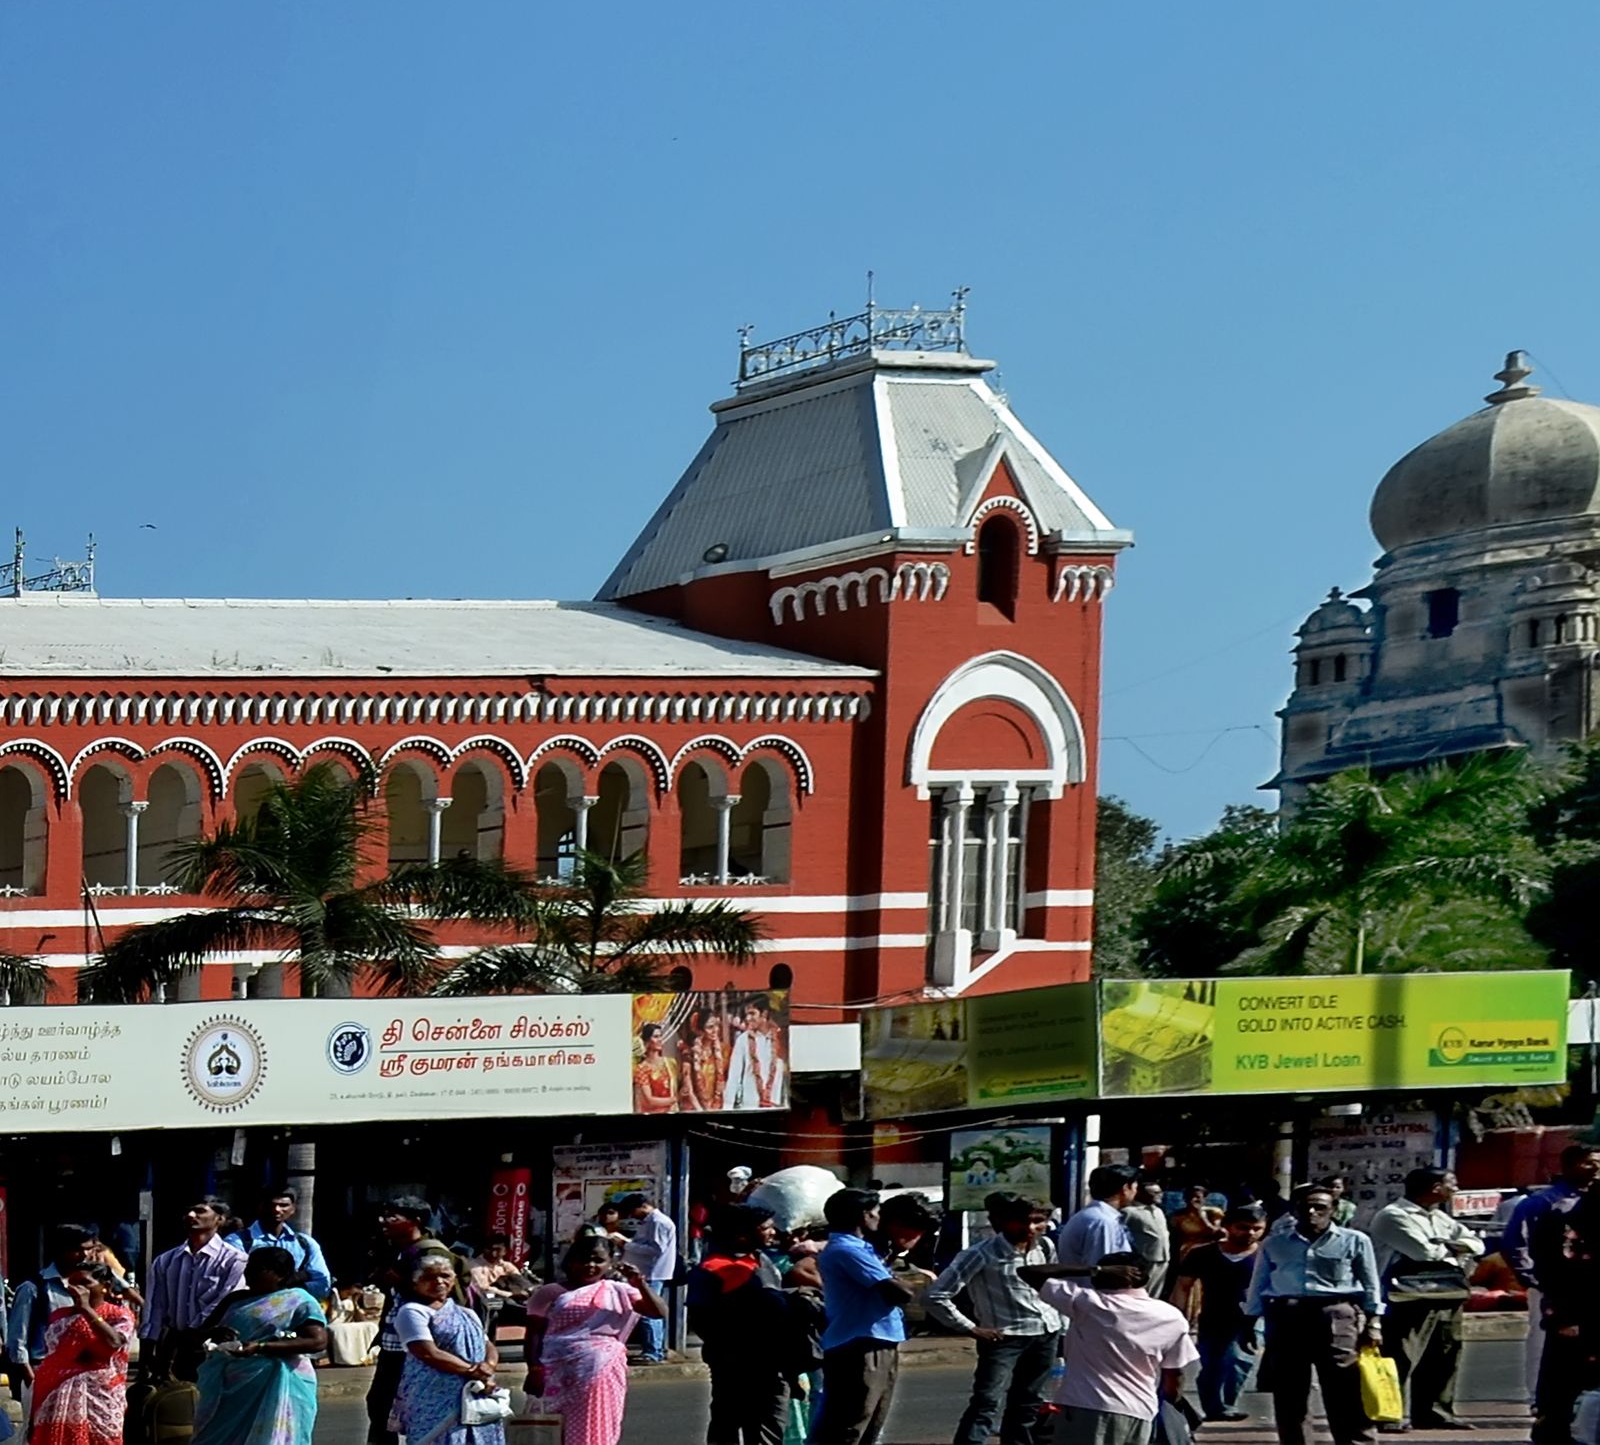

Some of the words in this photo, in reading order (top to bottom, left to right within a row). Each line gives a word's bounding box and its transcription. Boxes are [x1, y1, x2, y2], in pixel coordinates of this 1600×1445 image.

[1239, 996, 1303, 1011] CONVERT
[1307, 995, 1338, 1009] IDLE
[1237, 1017, 1276, 1032] GOLD
[1280, 1017, 1312, 1031] INTO
[1316, 1015, 1362, 1030] ACTIVE
[1367, 1014, 1407, 1029] CASH.
[380, 1020, 402, 1049] தி
[412, 1018, 503, 1042] சென்னை
[509, 1016, 590, 1039] சில்க்ஸ்
[1526, 1038, 1549, 1046] Bank
[30, 1046, 90, 1064] தாரணம்
[410, 1051, 477, 1075] குமரன்
[483, 1050, 596, 1072] தங்கமாளிகை
[1235, 1055, 1269, 1070] KVB
[1273, 1054, 1317, 1069] Jewel
[1323, 1053, 1361, 1068] Loan
[514, 1200, 525, 1263] vodafone
